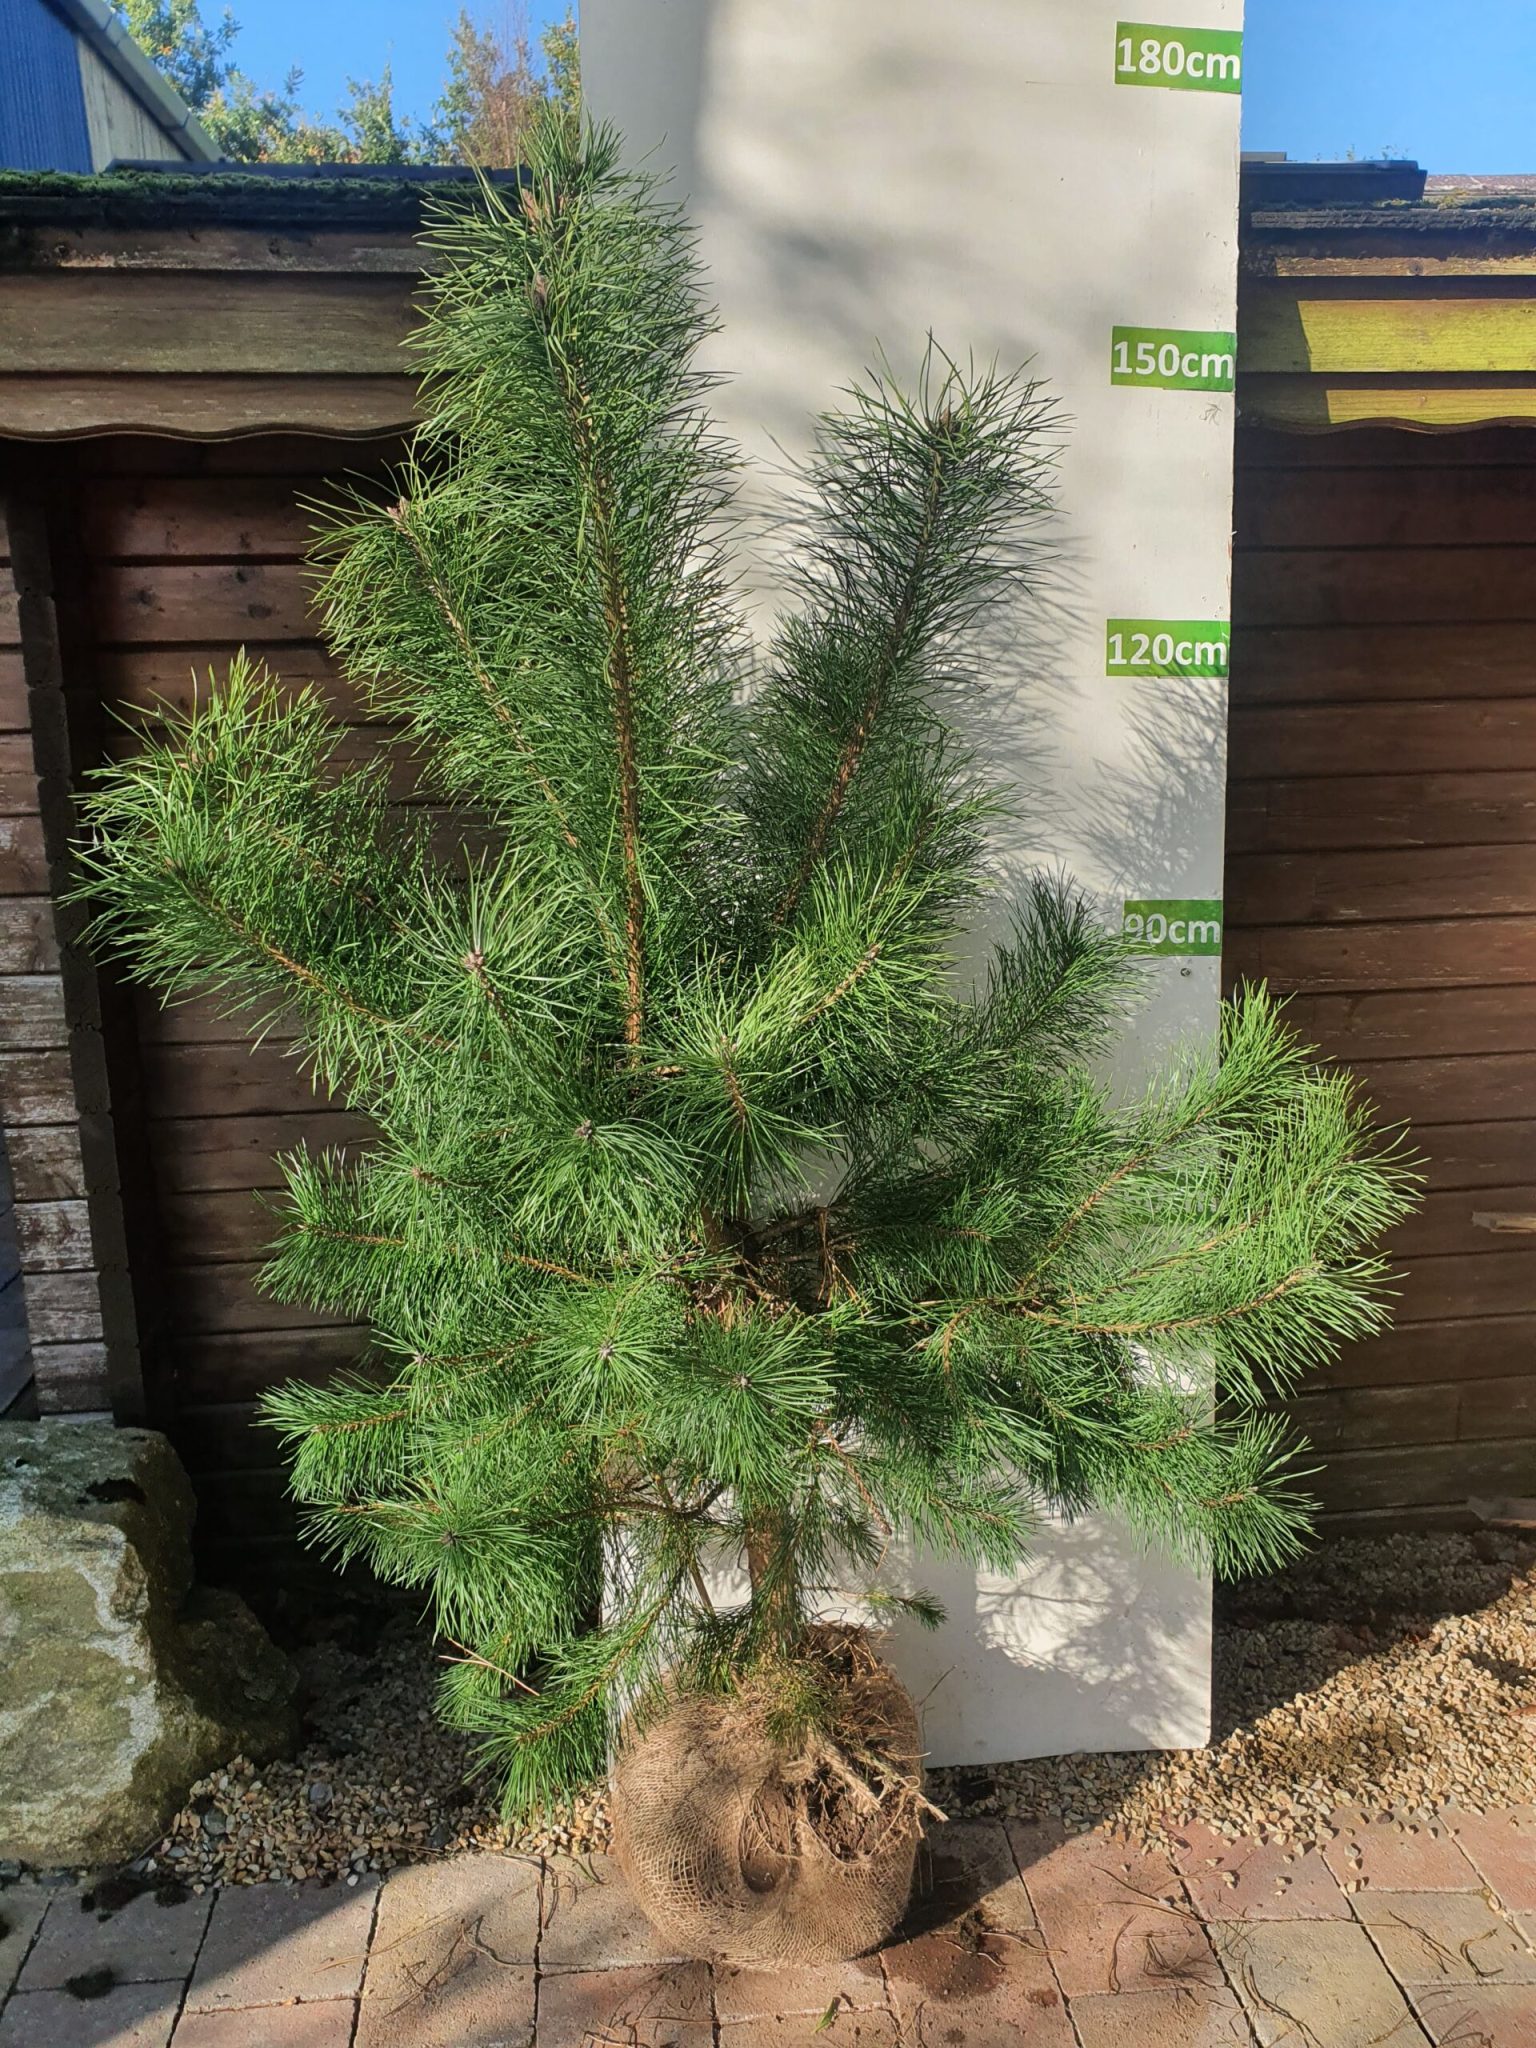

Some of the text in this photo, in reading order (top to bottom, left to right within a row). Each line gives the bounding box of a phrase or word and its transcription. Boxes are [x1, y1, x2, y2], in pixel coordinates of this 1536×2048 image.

[1117, 38, 1241, 79] 180cm
[1113, 341, 1234, 379] 150cm
[1108, 633, 1227, 665] 120cm
[1124, 913, 1221, 944] 90cm
